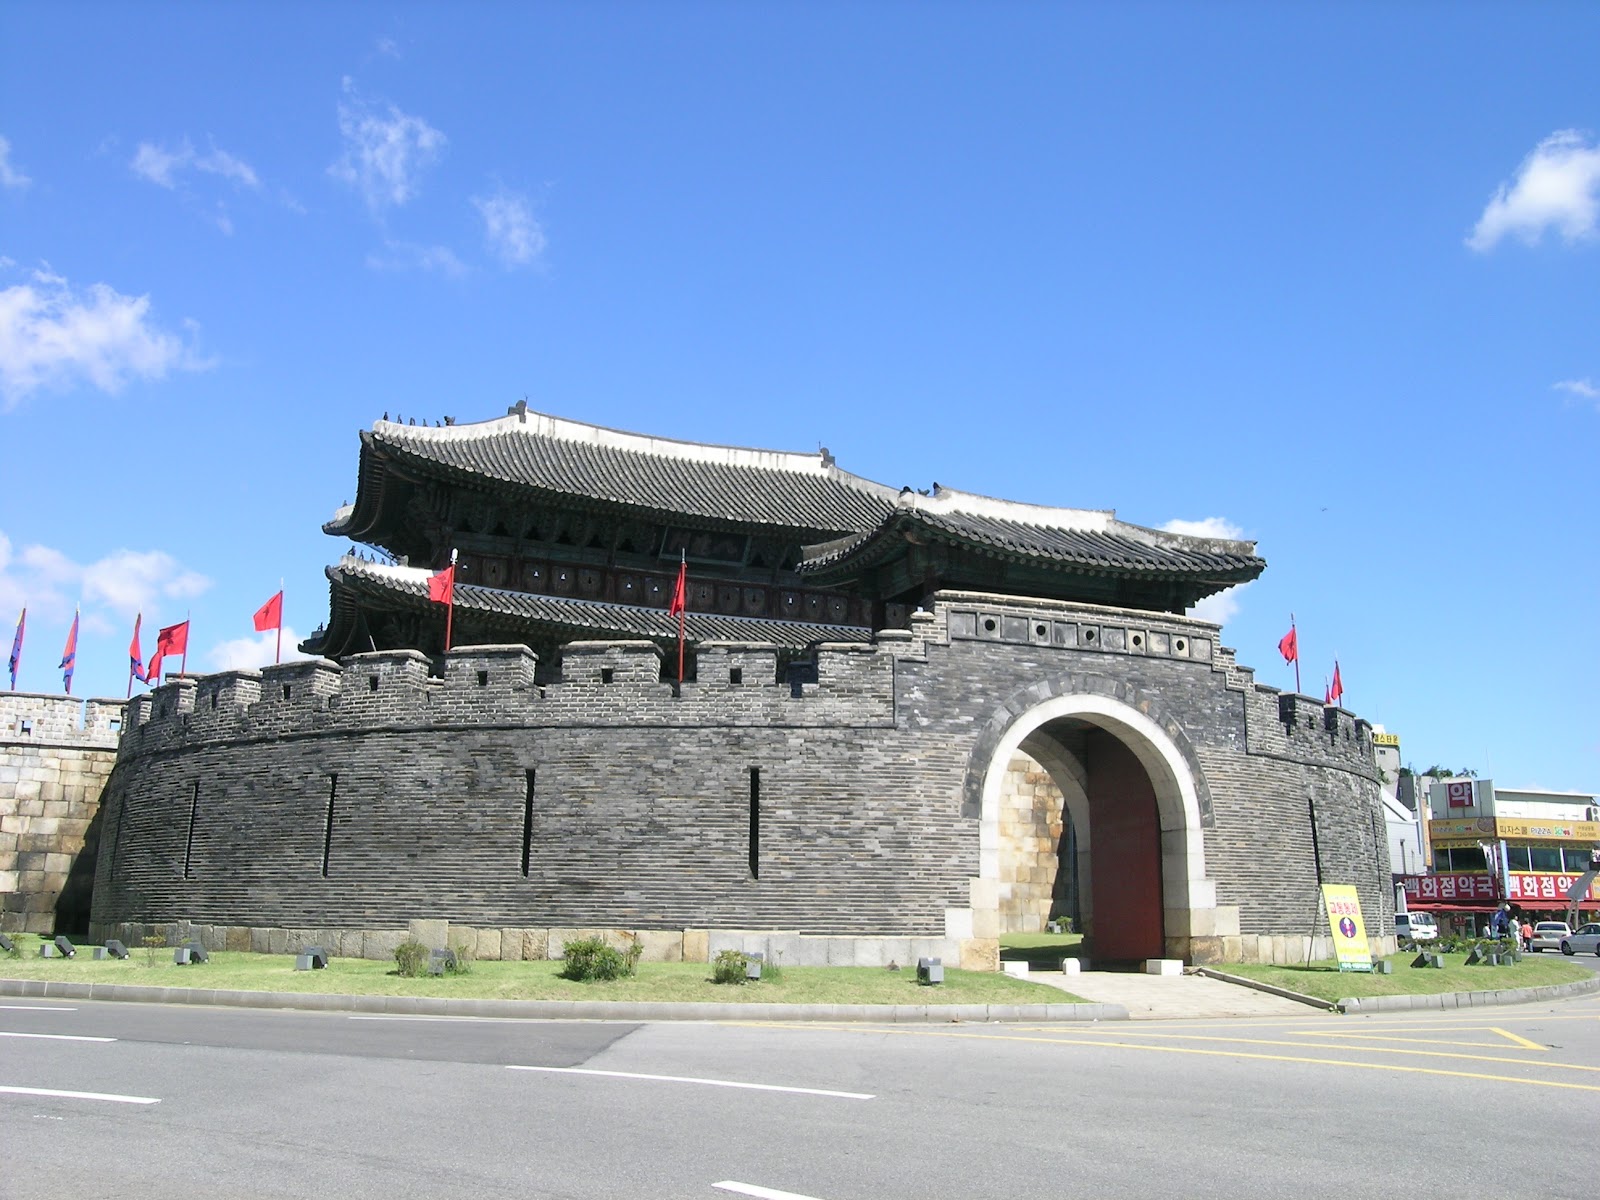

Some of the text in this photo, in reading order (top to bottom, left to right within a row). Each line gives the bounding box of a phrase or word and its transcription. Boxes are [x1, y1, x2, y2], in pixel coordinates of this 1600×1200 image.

[1450, 783, 1472, 806] 약
[1404, 876, 1494, 898] 백화점약국
[1509, 875, 1590, 898] 백화점약
